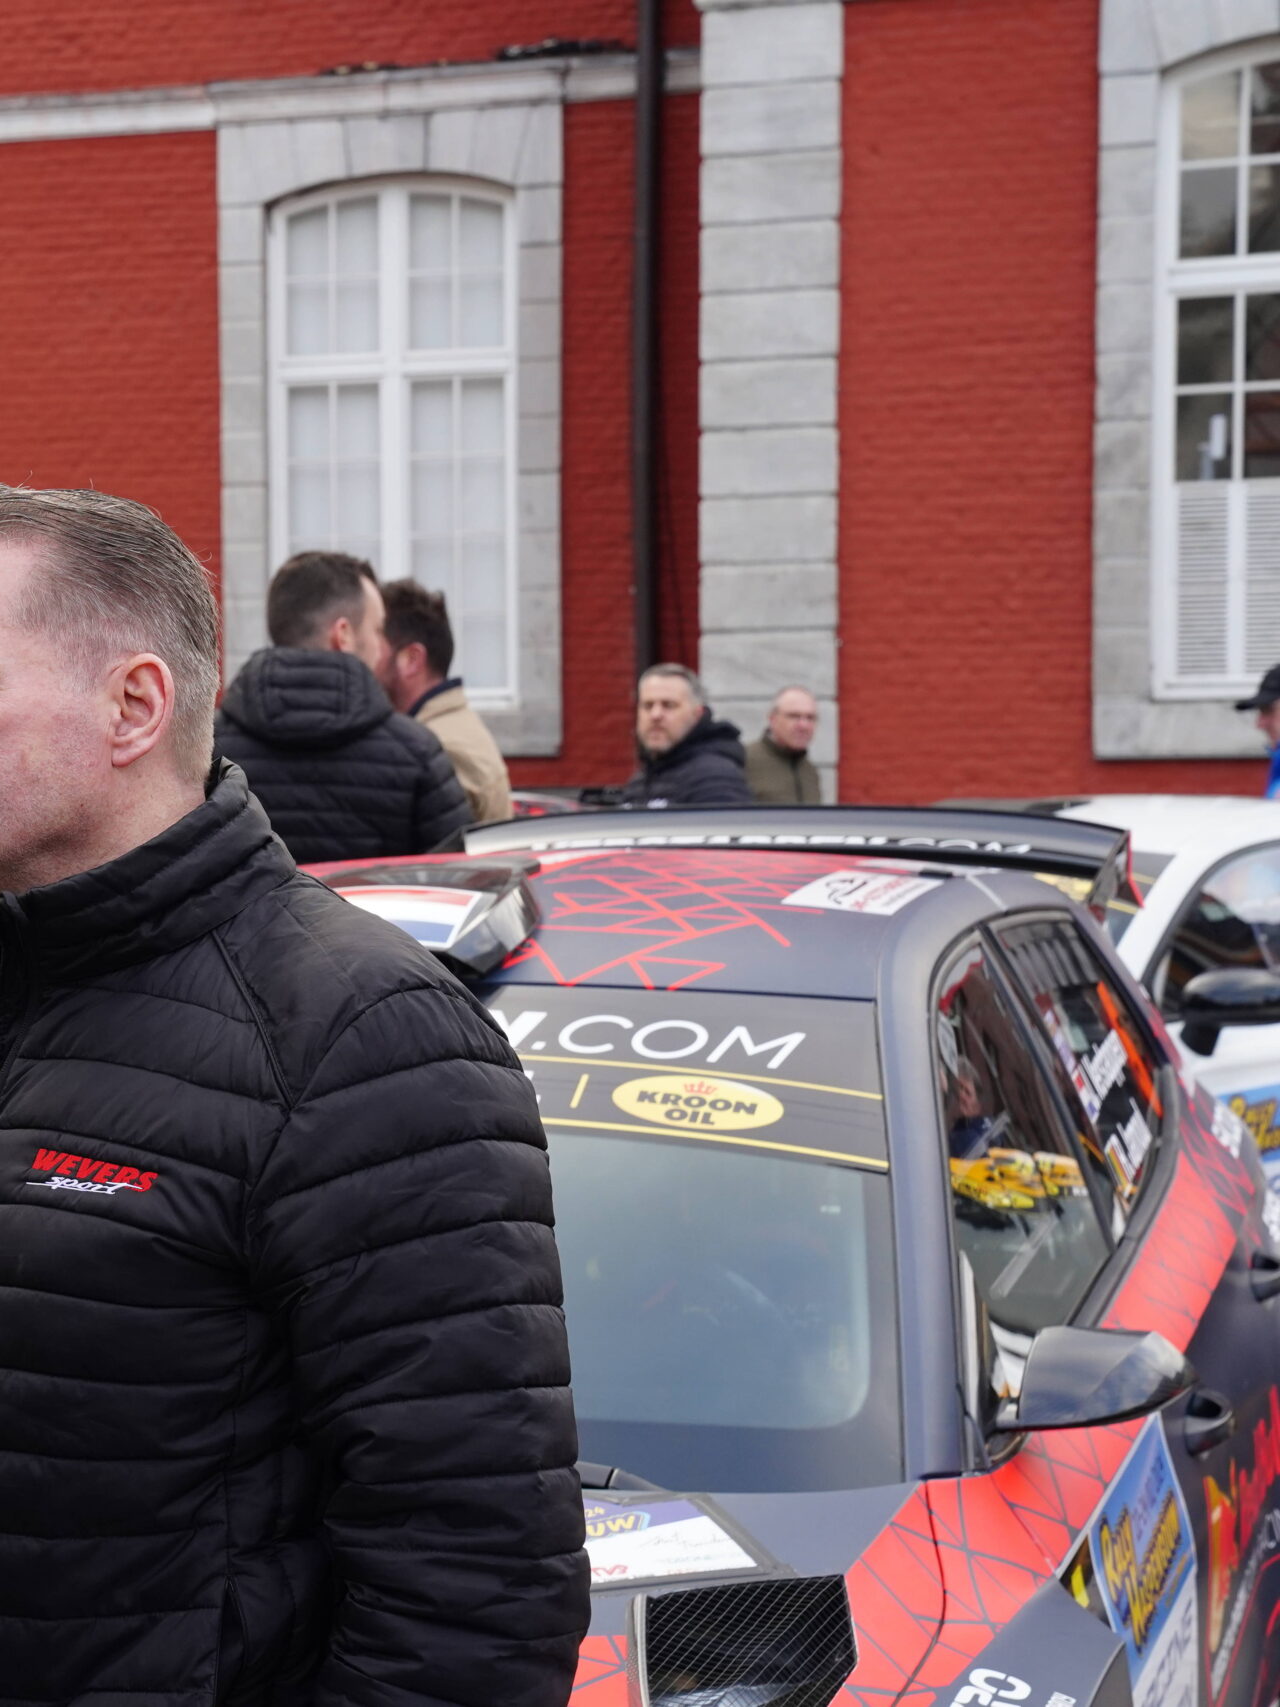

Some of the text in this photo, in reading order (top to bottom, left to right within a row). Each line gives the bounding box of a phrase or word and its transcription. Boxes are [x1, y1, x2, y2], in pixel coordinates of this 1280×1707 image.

[636, 1090, 759, 1117] KROON
[663, 1108, 716, 1127] OIL
[31, 1148, 159, 1192] WEVERS
